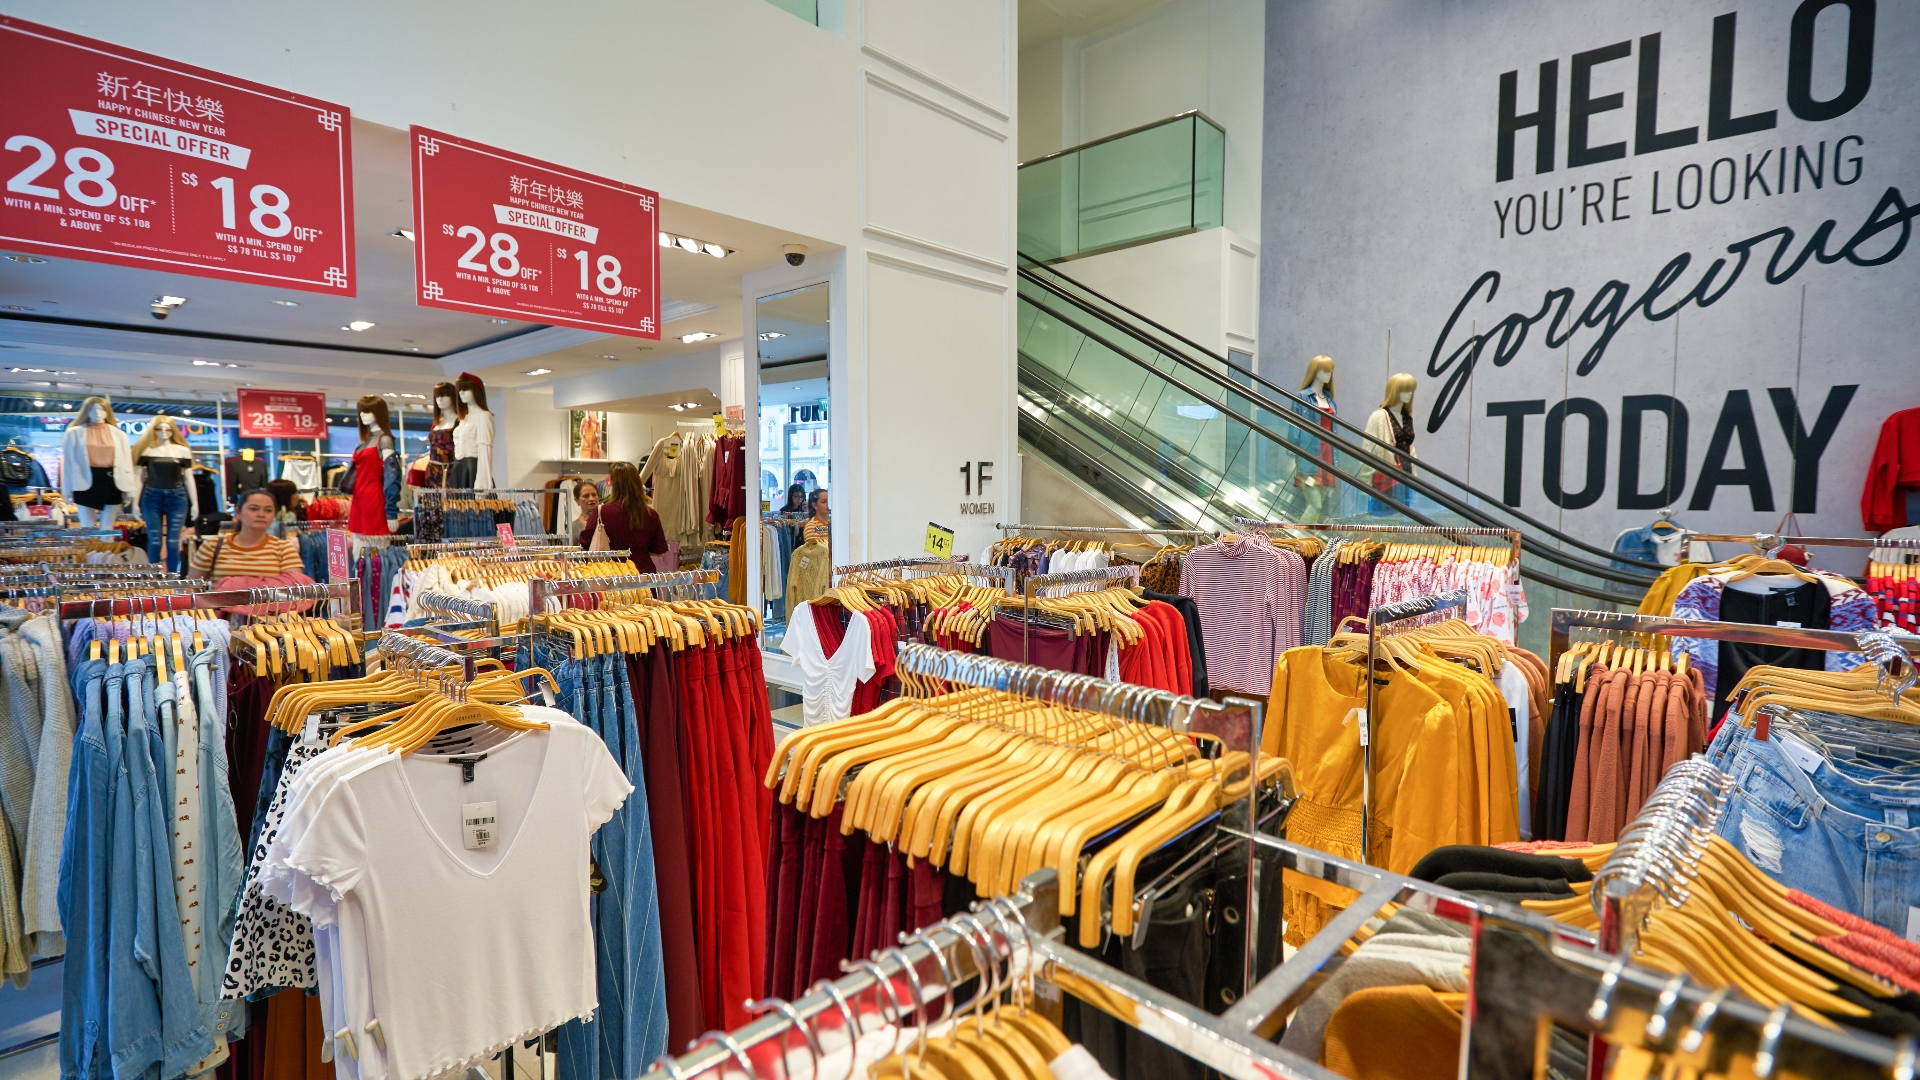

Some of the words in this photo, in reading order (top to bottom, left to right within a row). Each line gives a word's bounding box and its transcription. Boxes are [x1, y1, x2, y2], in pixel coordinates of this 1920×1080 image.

[97, 72, 225, 124] 新年快樂
[1496, 0, 1877, 183] HELLO
[97, 99, 131, 115] HAPPY
[134, 107, 177, 126] CHINESE
[179, 118, 200, 131] NEW
[202, 123, 226, 137] YEAR
[95, 118, 171, 147] SPECIAL
[177, 135, 230, 161] OFFER
[4, 134, 117, 207] 28
[1494, 175, 1633, 239] YOU'RE
[1652, 134, 1866, 215] LOOKING
[181, 171, 198, 187] S$
[210, 176, 292, 238] 18
[509, 174, 584, 210] 新年快樂
[509, 195, 530, 207] HAPPY
[530, 201, 555, 213] CHINESE
[556, 207, 569, 216] NEW
[570, 209, 584, 220] YEAR
[4, 196, 31, 210] WITH
[33, 202, 42, 211] A
[43, 203, 66, 216] MIN.
[68, 207, 101, 221] SPEND
[104, 213, 116, 223] OF
[118, 215, 131, 226] S$
[133, 218, 151, 229] 108
[59, 217, 68, 227] &
[70, 219, 102, 233] ABOVE
[508, 210, 552, 230] SPECIAL
[554, 220, 586, 238] OFFER
[215, 231, 237, 243] WITH
[238, 235, 246, 245] A
[246, 237, 265, 248] MIN.
[266, 240, 292, 252] SPEND
[293, 244, 304, 254] OF
[227, 244, 239, 255] S$
[240, 247, 251, 256] 78
[252, 248, 269, 260] TILL
[270, 250, 281, 262] S$
[282, 253, 296, 263] 107
[442, 223, 455, 236] S$
[456, 225, 520, 278] 28
[455, 271, 472, 281] WITH
[472, 274, 477, 282] A
[492, 277, 511, 288] SPEND
[511, 280, 520, 289] OF
[556, 247, 567, 259] S$
[573, 249, 623, 296] 18
[486, 285, 492, 293] &
[492, 286, 511, 297] ABOVE
[575, 292, 589, 301] WITH
[605, 297, 622, 307] SPEND
[622, 300, 629, 308] OF
[1426, 186, 1920, 434] Gorgeous
[252, 412, 275, 427] 28
[293, 414, 313, 428] 18
[1487, 383, 1860, 515] TODAY
[960, 461, 994, 496] 1F
[960, 502, 995, 515] WOMEN
